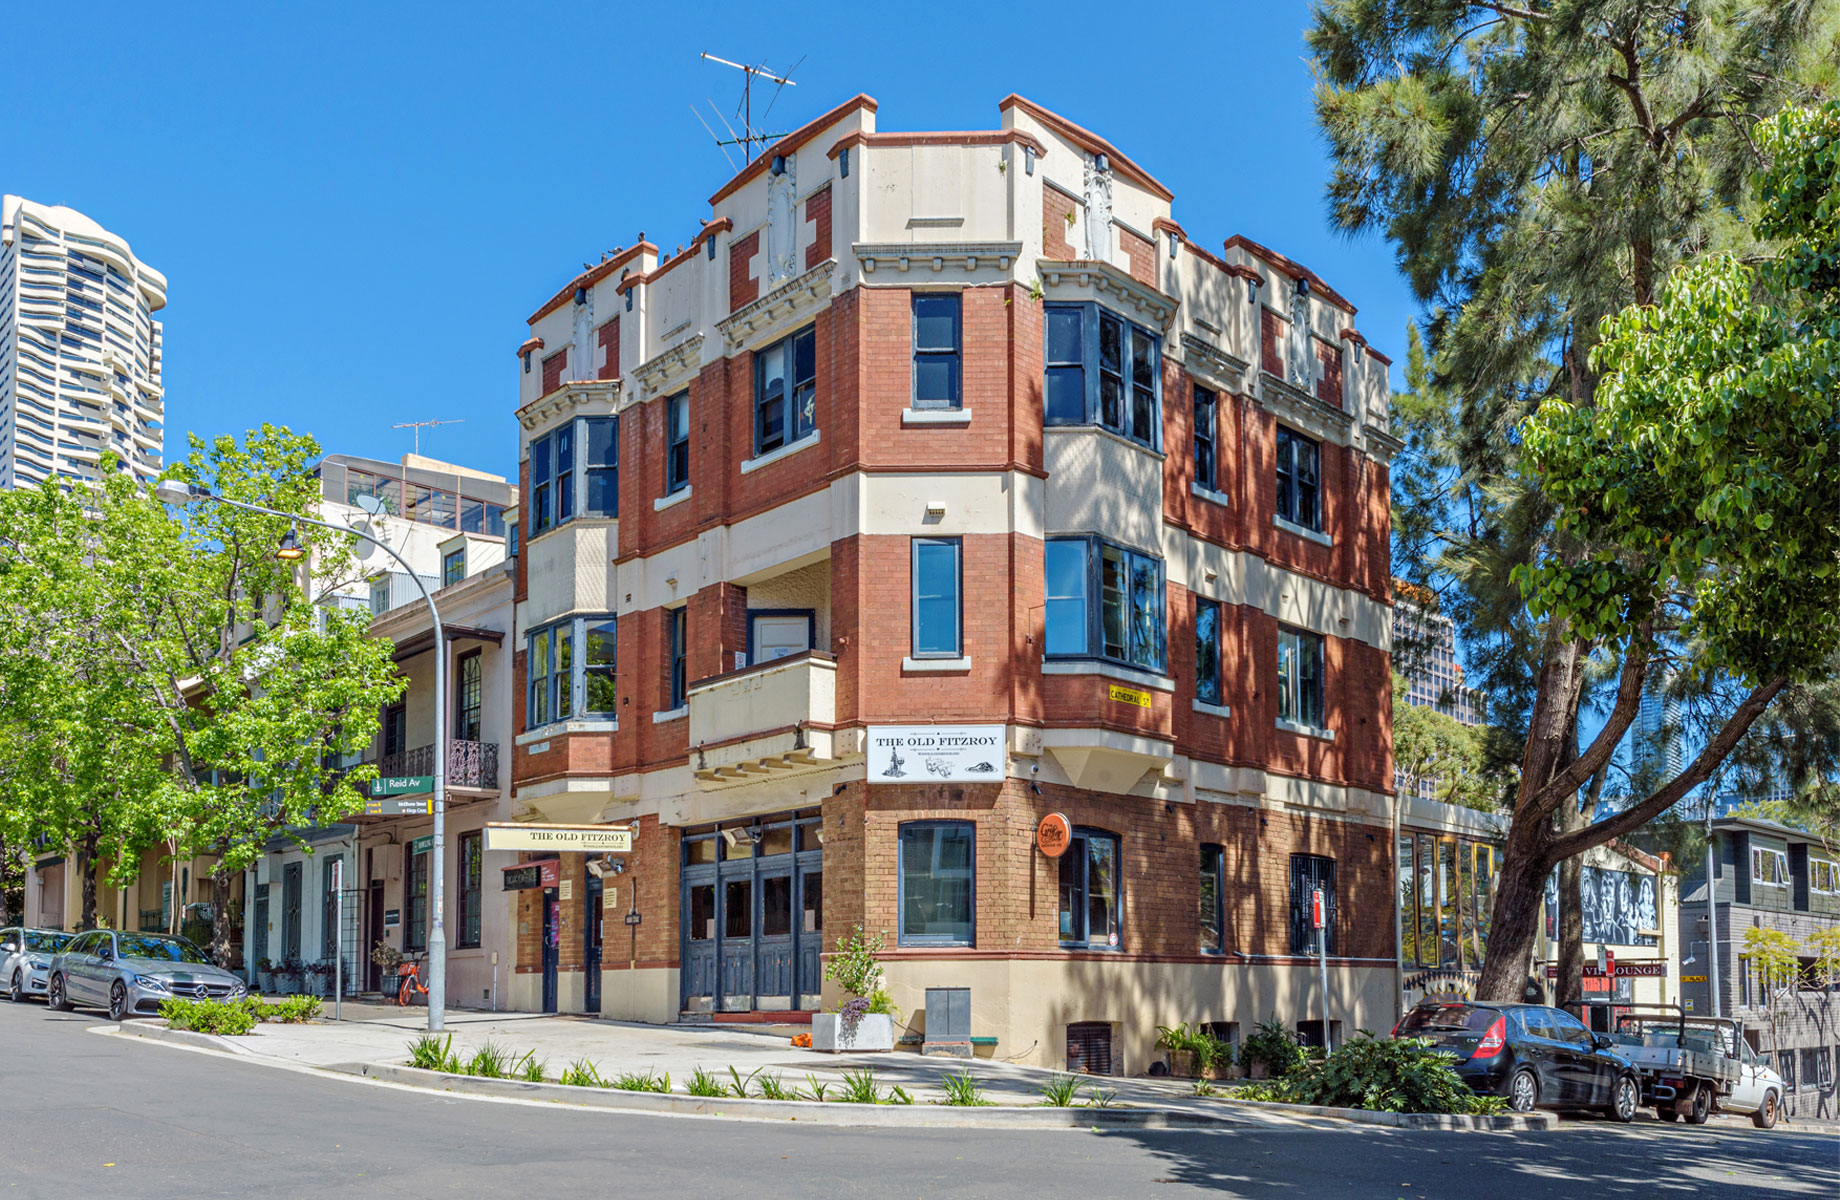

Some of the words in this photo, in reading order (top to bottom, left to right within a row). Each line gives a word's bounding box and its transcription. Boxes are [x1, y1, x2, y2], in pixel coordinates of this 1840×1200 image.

[1110, 690, 1140, 704] CATHEDRAL
[1143, 697, 1150, 706] ST
[876, 737, 904, 747] THE
[907, 737, 935, 746] OLD
[939, 736, 997, 746] FITZROY
[389, 779, 407, 788] Reid
[408, 778, 420, 787] Av
[530, 832, 553, 840] THE
[555, 832, 578, 841] OLD
[581, 833, 625, 842] FITZROY
[1613, 966, 1660, 976] OUNGE
